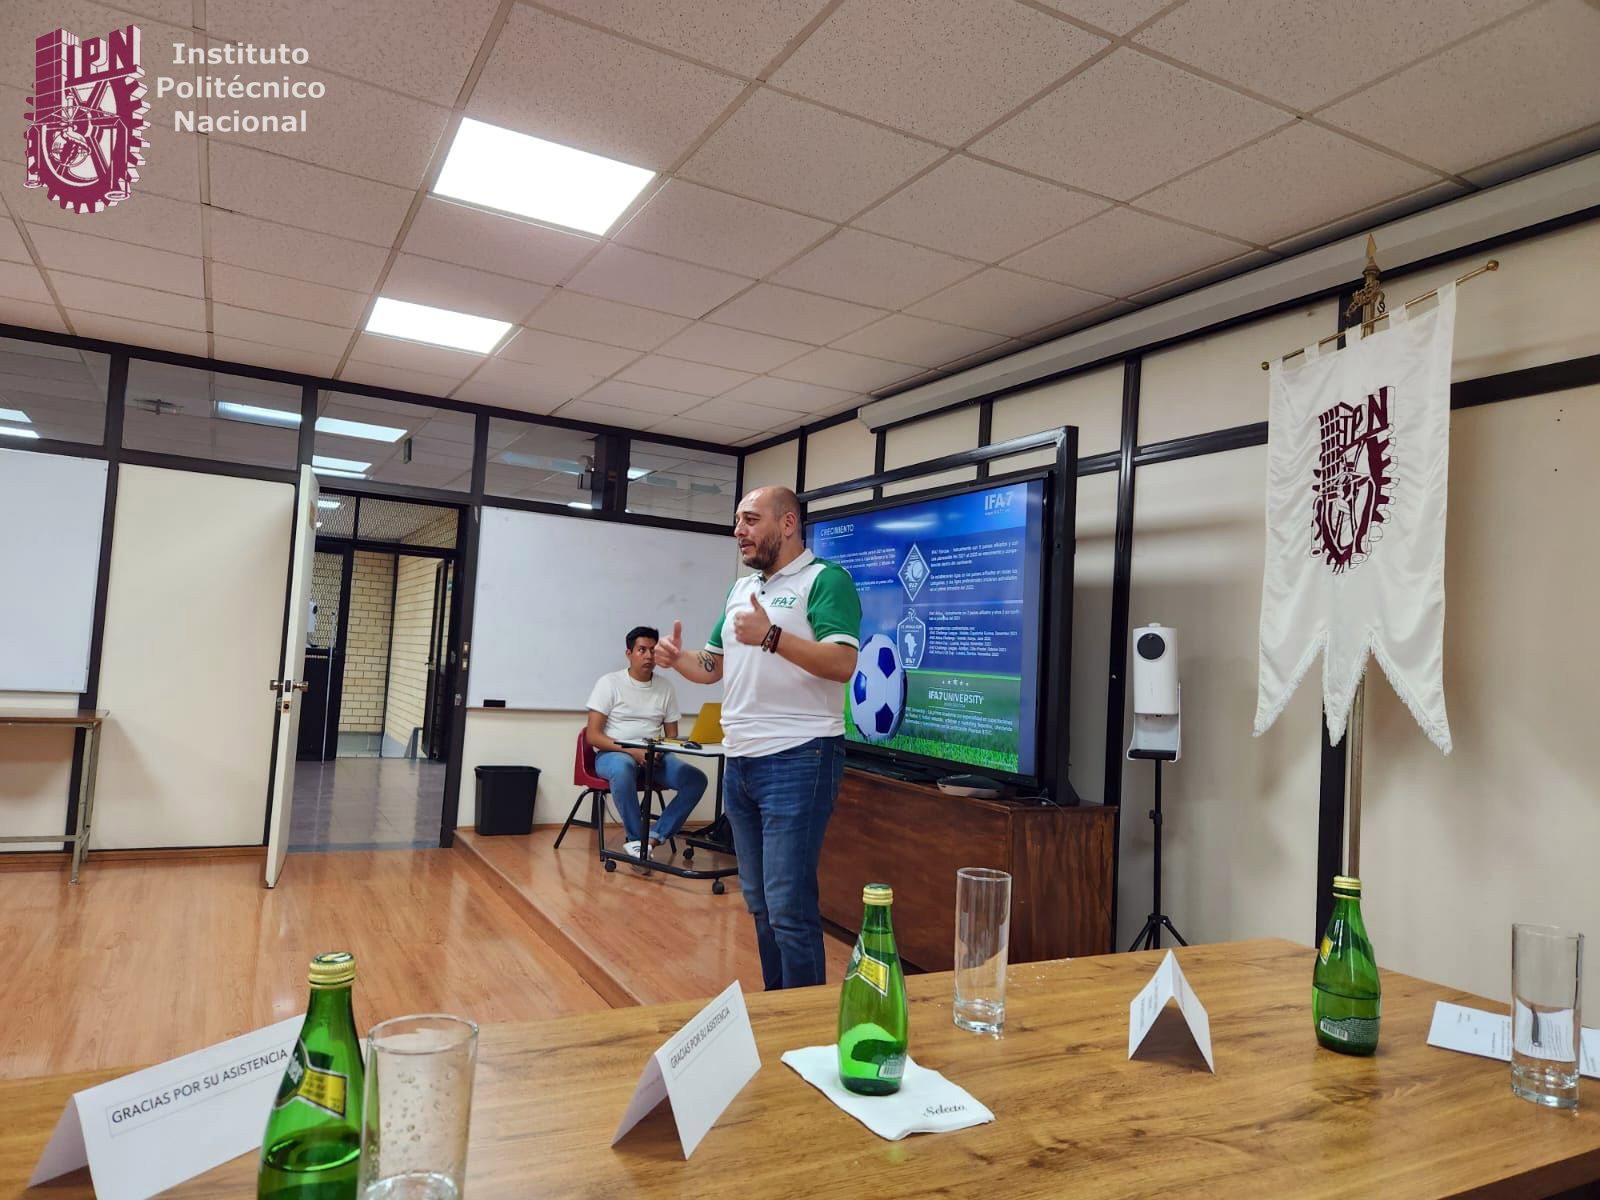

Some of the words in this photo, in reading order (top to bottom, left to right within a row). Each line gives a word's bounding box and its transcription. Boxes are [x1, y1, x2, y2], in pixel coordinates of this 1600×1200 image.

[670, 1042, 691, 1069] GRACIAS
[690, 1030, 702, 1047] POR
[700, 1026, 708, 1041] SU
[706, 1006, 730, 1033] ASISTENCIA
[111, 1093, 171, 1124] GRACIAS
[173, 1082, 202, 1101] POR
[203, 1073, 222, 1090] SU
[222, 1048, 288, 1083] ASISTENCIA
